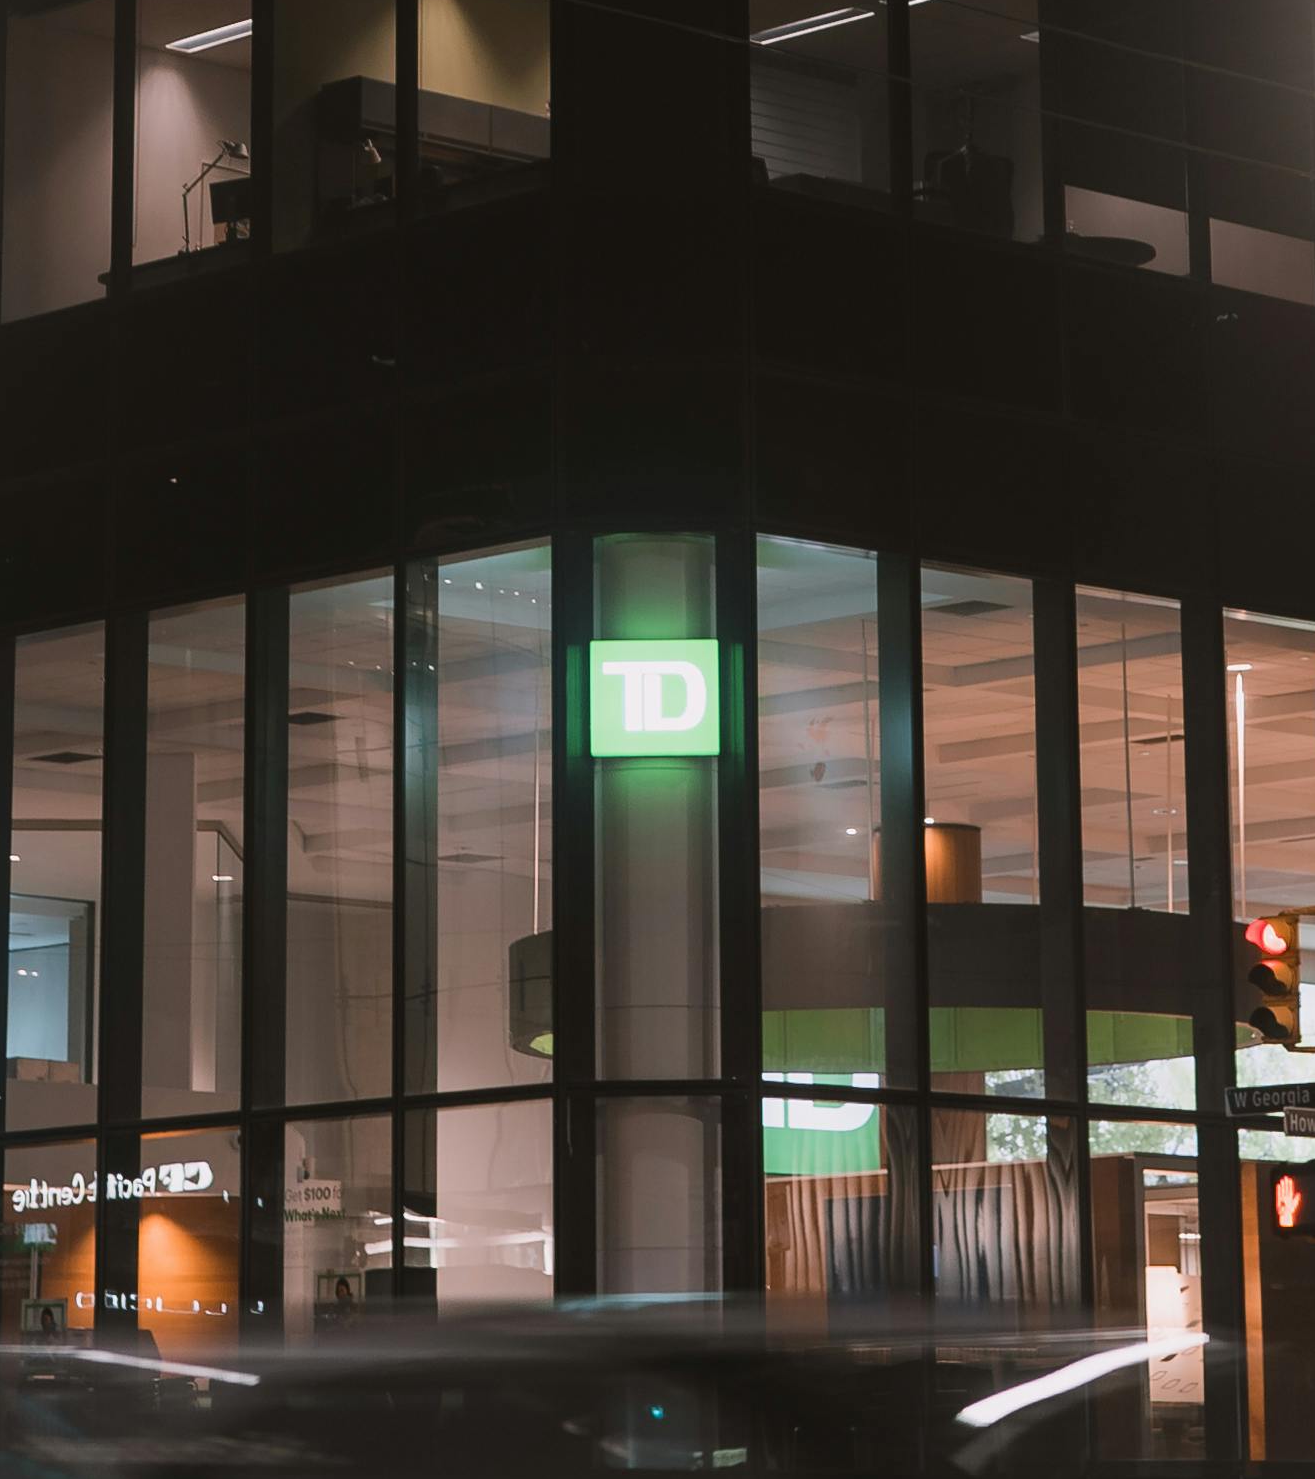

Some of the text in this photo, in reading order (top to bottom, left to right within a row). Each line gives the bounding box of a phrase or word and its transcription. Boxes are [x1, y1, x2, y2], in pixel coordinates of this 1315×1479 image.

[602, 660, 707, 732] TD
[1234, 1090, 1247, 1109] W
[1252, 1085, 1311, 1108] Georgia
[304, 1186, 331, 1202] $100
